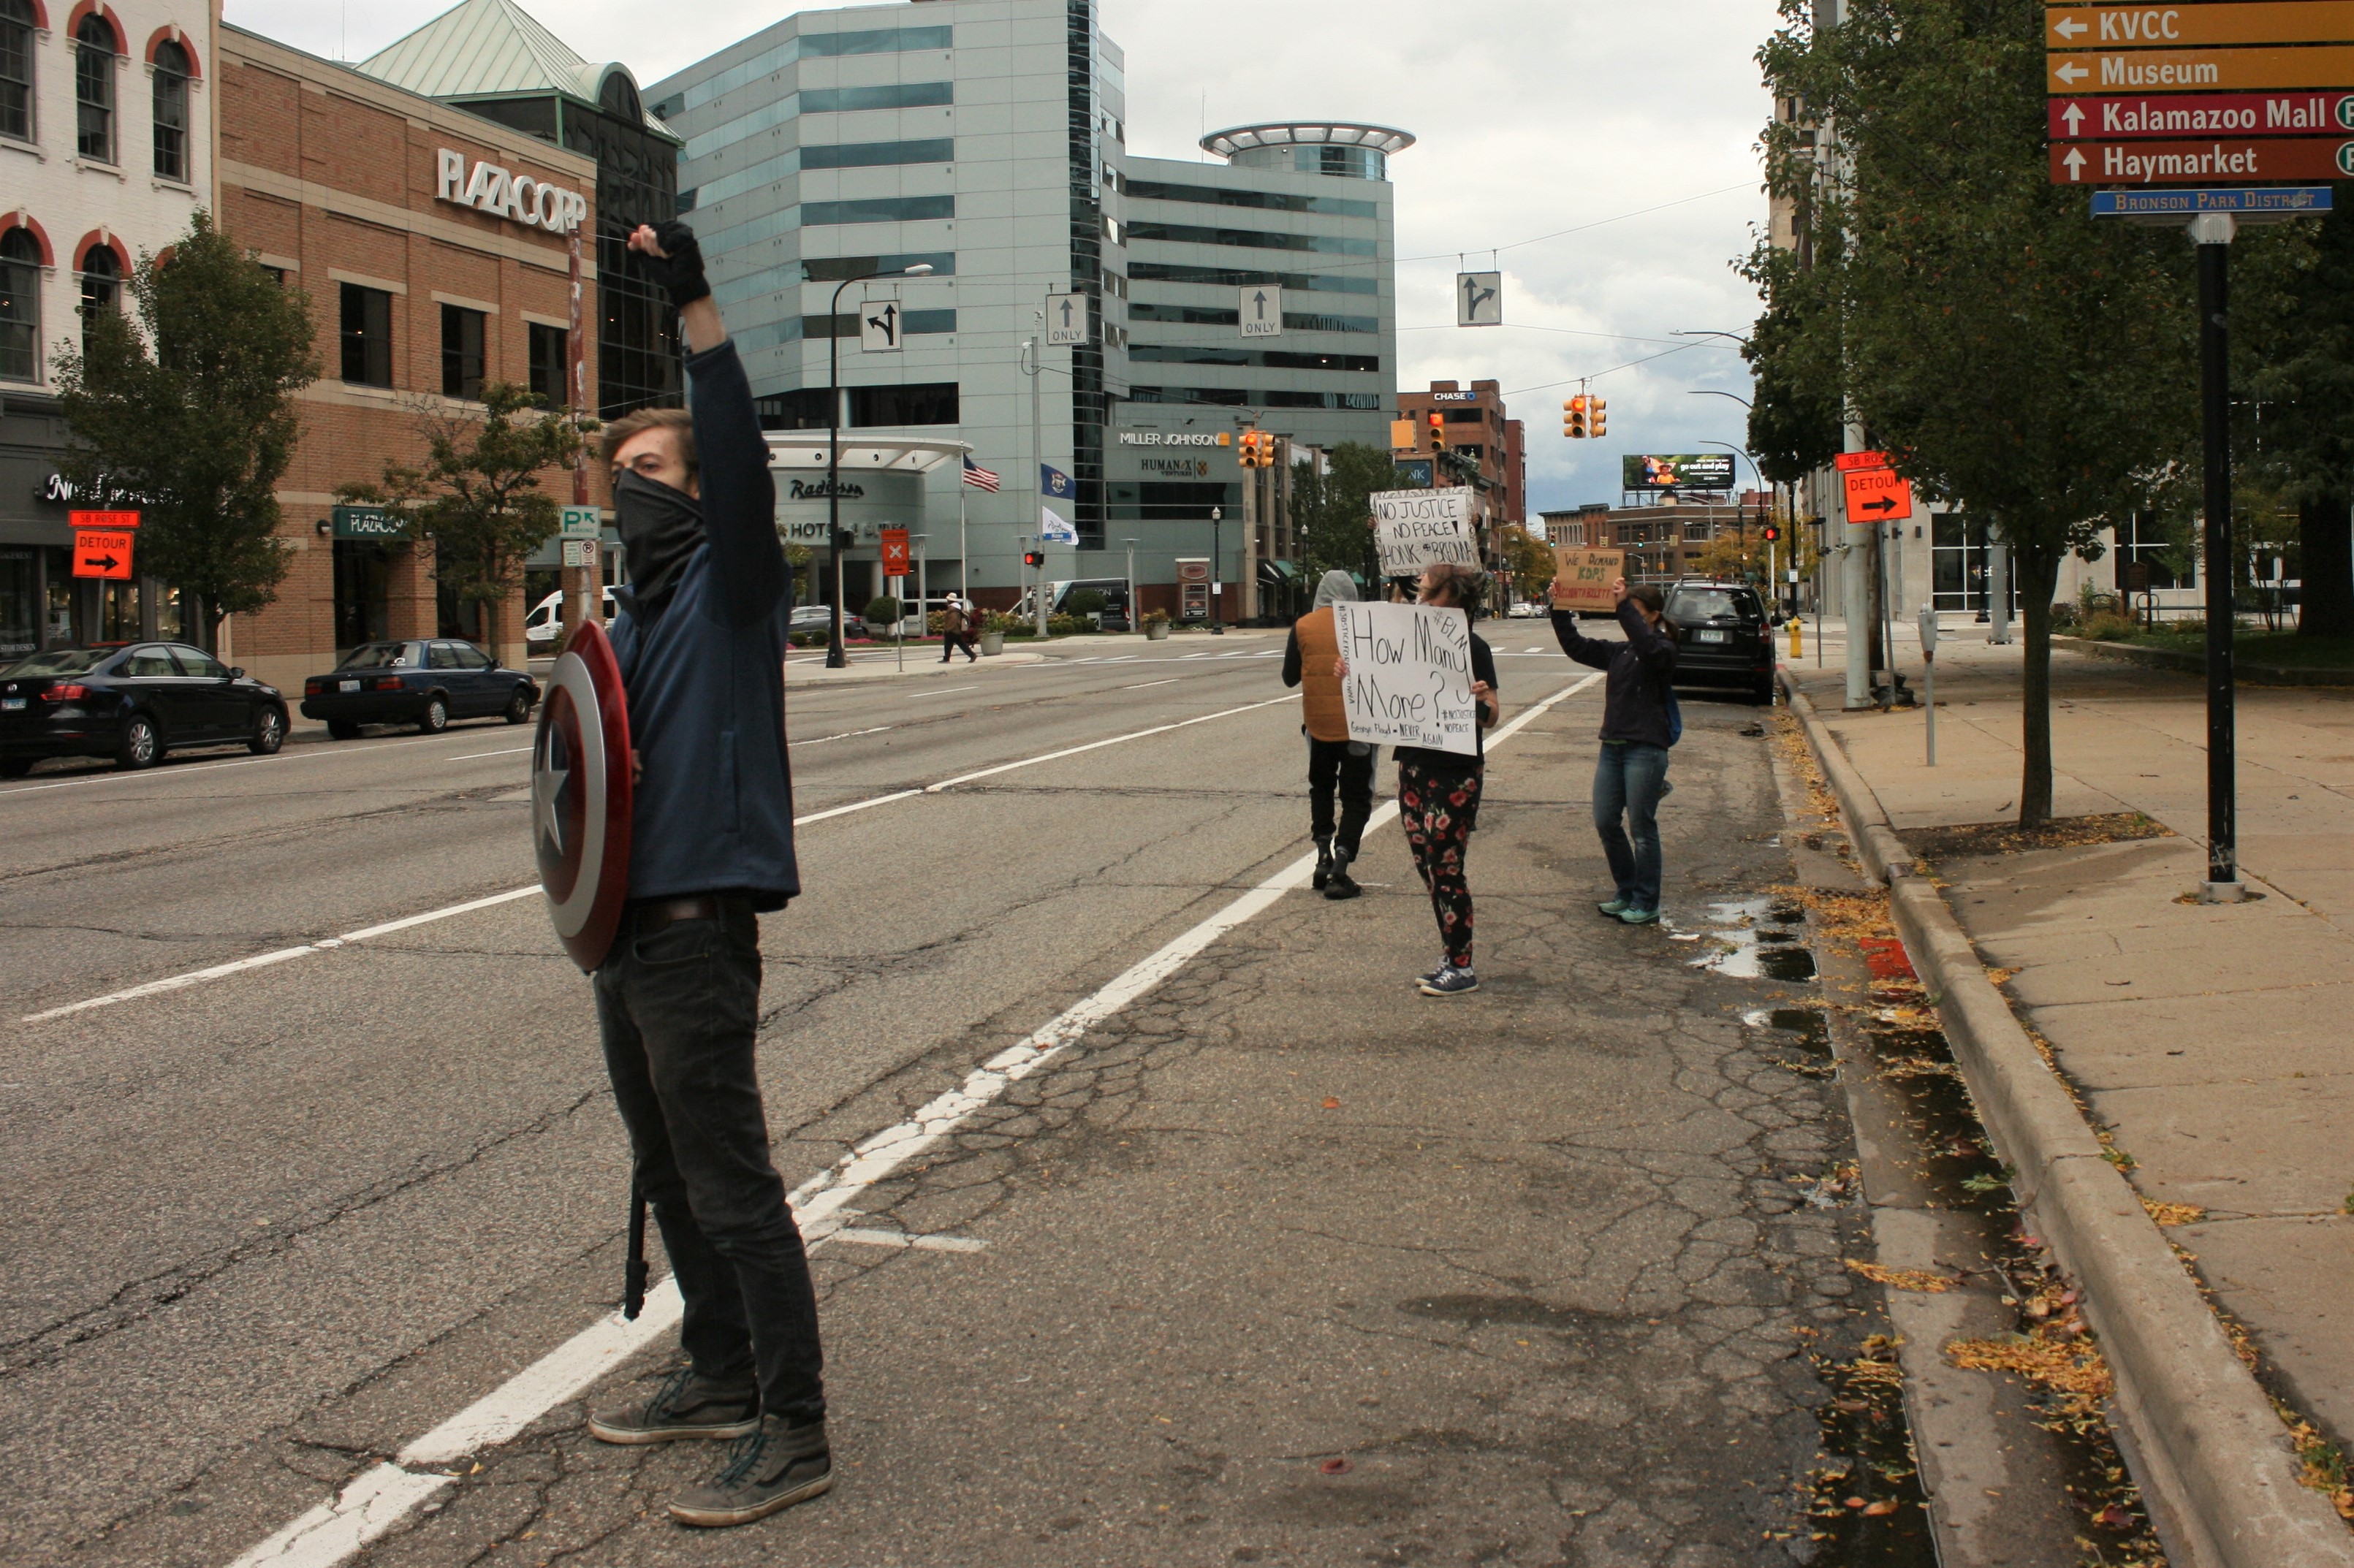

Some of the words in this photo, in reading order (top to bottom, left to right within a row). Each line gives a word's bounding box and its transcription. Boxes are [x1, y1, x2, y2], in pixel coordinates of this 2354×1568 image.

[2100, 10, 2179, 40] KVCC
[2100, 57, 2218, 85] Museum
[2103, 102, 2256, 132] Kalamazoo
[2266, 98, 2325, 129] Mall
[2104, 144, 2258, 183] Haymarket
[438, 148, 586, 234] PLAZACORP
[1246, 323, 1275, 333] ONLY
[1053, 330, 1082, 341] ONLY
[1434, 392, 1466, 400] CHASE
[1120, 433, 1161, 445] MILLER
[1163, 434, 1218, 446] JOHNSON
[1715, 463, 1729, 471] play
[1848, 456, 1860, 466] SB
[1864, 454, 1884, 464] ROS
[80, 513, 91, 522] SB
[95, 514, 117, 523] ROSE
[122, 514, 130, 522] ST
[1378, 502, 1397, 520] NO
[80, 536, 126, 549] DETOUR
[1383, 544, 1421, 566] HONK
[1578, 566, 1606, 582] KDPS
[1433, 609, 1468, 652] #BLM
[16, 643, 36, 651] DESIGN
[1351, 609, 1405, 664] How
[1415, 612, 1471, 704] Many
[1374, 723, 1391, 737] Floyd
[1400, 723, 1420, 737] NEVER
[1423, 733, 1443, 746] AGAIN
